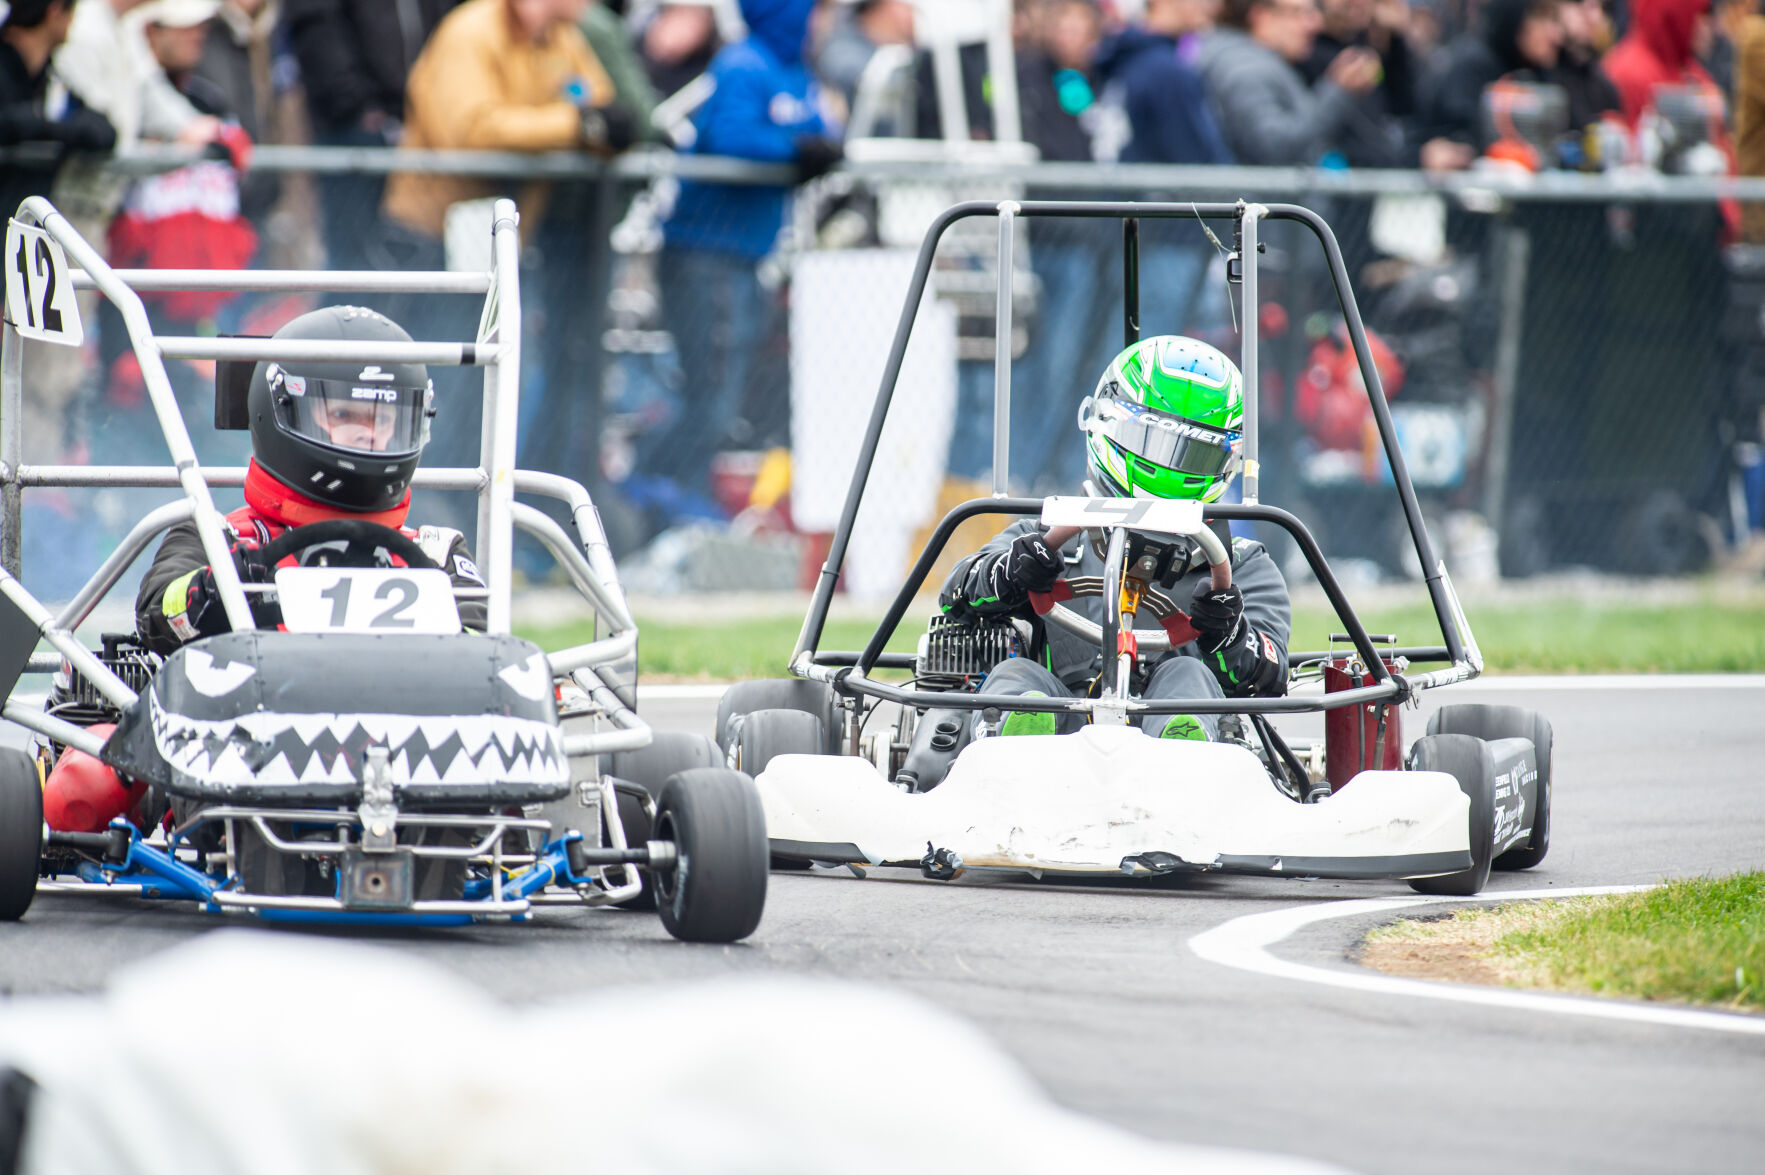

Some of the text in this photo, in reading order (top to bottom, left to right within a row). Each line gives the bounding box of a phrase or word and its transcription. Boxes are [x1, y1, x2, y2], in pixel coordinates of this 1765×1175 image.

[16, 233, 64, 333] 12
[351, 387, 398, 402] zamp
[1138, 412, 1227, 445] COMET
[1083, 499, 1155, 524] 4
[319, 576, 420, 629] 12
